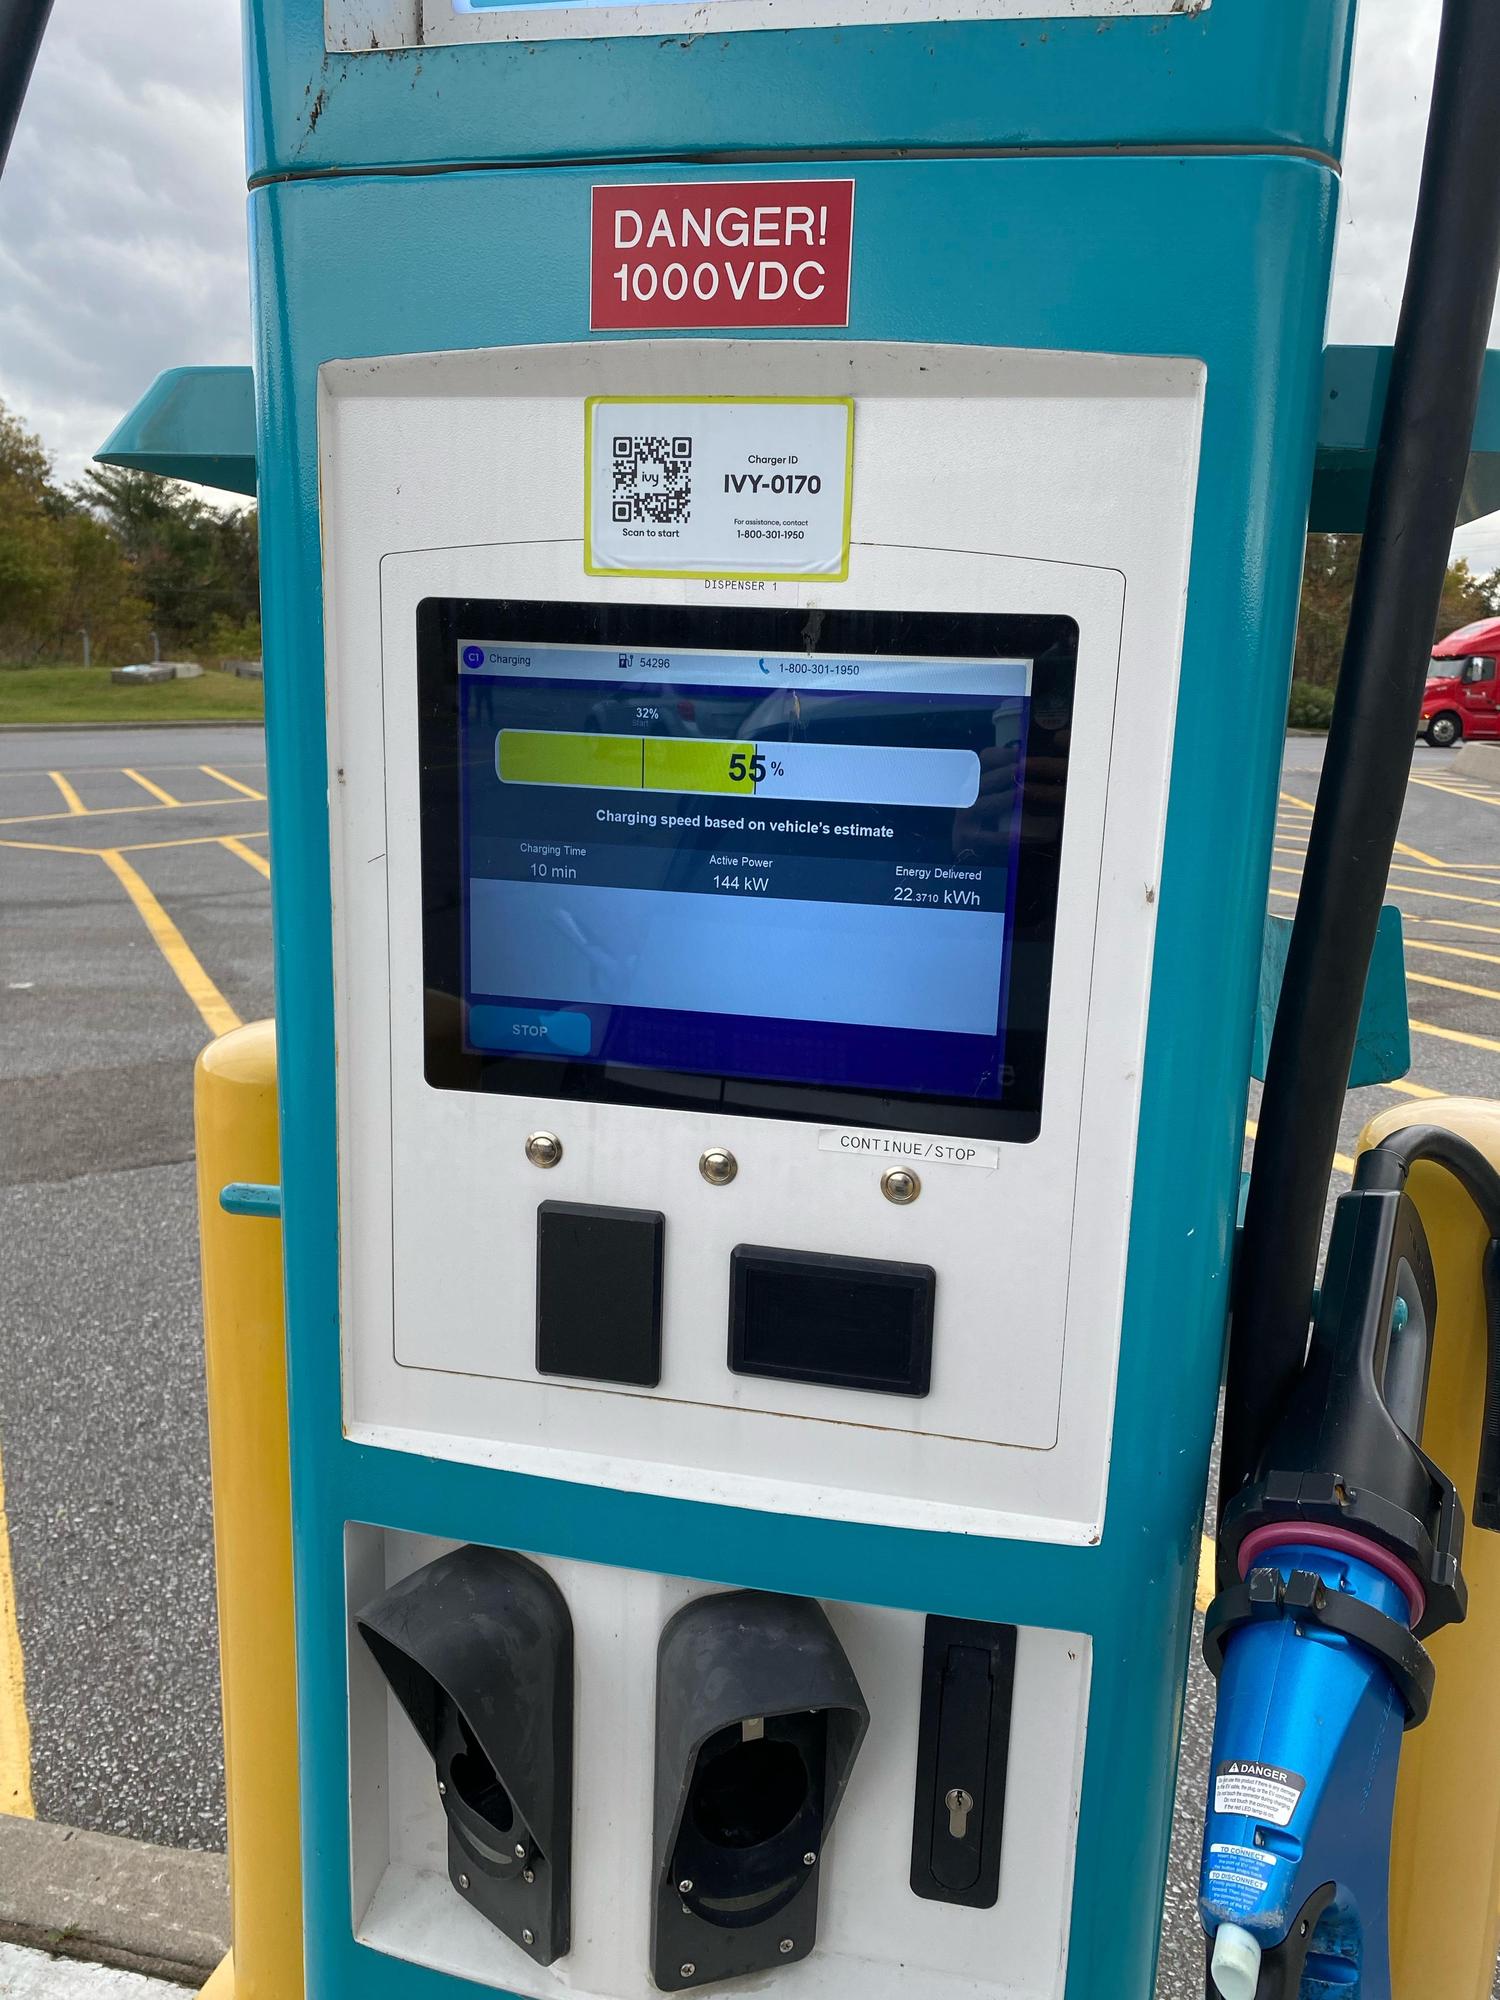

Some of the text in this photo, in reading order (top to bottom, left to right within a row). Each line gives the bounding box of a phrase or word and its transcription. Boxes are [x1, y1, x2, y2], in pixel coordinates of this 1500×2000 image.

[614, 206, 828, 249] DANGER!
[613, 260, 826, 302] 1000VDC
[748, 455, 799, 467] Charger ID
[641, 471, 659, 487] ivy
[724, 474, 822, 495] IVY-0170
[734, 518, 809, 528] For assistance, contact
[622, 528, 680, 538] Scan to start
[737, 529, 805, 541] 1-800-301-1950
[704, 579, 778, 592] DISPENSER 1
[468, 652, 479, 662] C1
[489, 653, 531, 668] Charging
[639, 657, 670, 669] 54296
[778, 662, 860, 676] 1-800-301-1950
[636, 707, 659, 720] 32%
[595, 809, 894, 838] Charging speed based on vehicle's estimate
[519, 842, 587, 857] Charging Time
[709, 854, 774, 869] Active Power
[530, 863, 577, 879] 10 min
[895, 865, 982, 881] Energy Delivered
[712, 875, 770, 892] 144 kW
[893, 886, 981, 906] 22.3710 kWh
[511, 1023, 549, 1038] STOP
[839, 1133, 977, 1161] CONTINUE/STOP
[1240, 1763, 1288, 1783] DANGER
[1230, 1847, 1265, 1861] CONNECT
[1221, 1872, 1264, 1888] DISCONNECT
